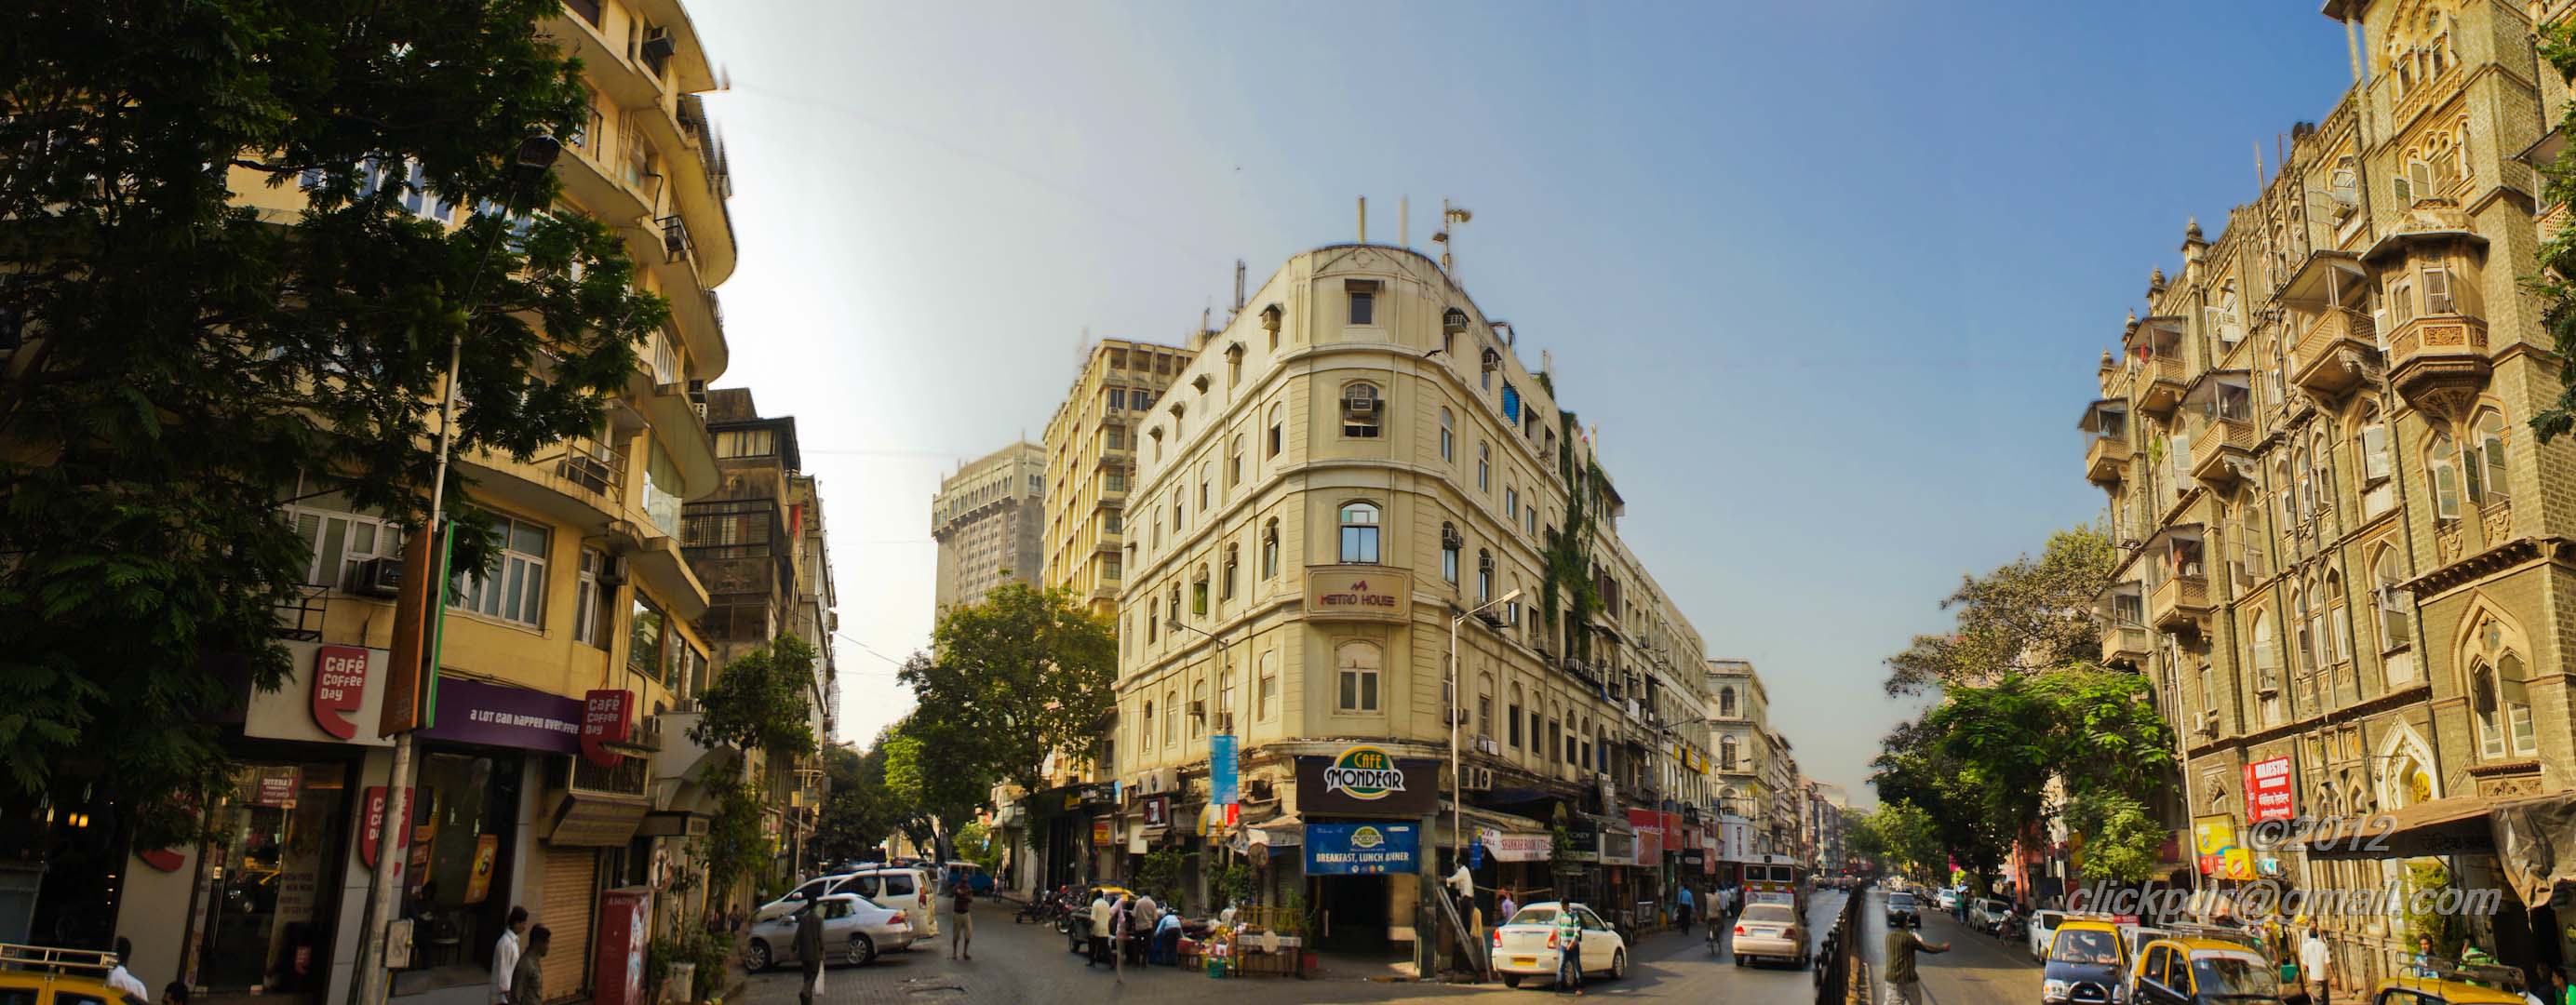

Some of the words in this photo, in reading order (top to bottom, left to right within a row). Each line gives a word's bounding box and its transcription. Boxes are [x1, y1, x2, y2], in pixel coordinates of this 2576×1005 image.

[1319, 594, 1358, 606] METRO
[322, 673, 363, 687] Coffee
[320, 688, 343, 702] Day
[1316, 852, 1359, 864] BREAKFAST,
[1359, 852, 1384, 863] LUNCH
